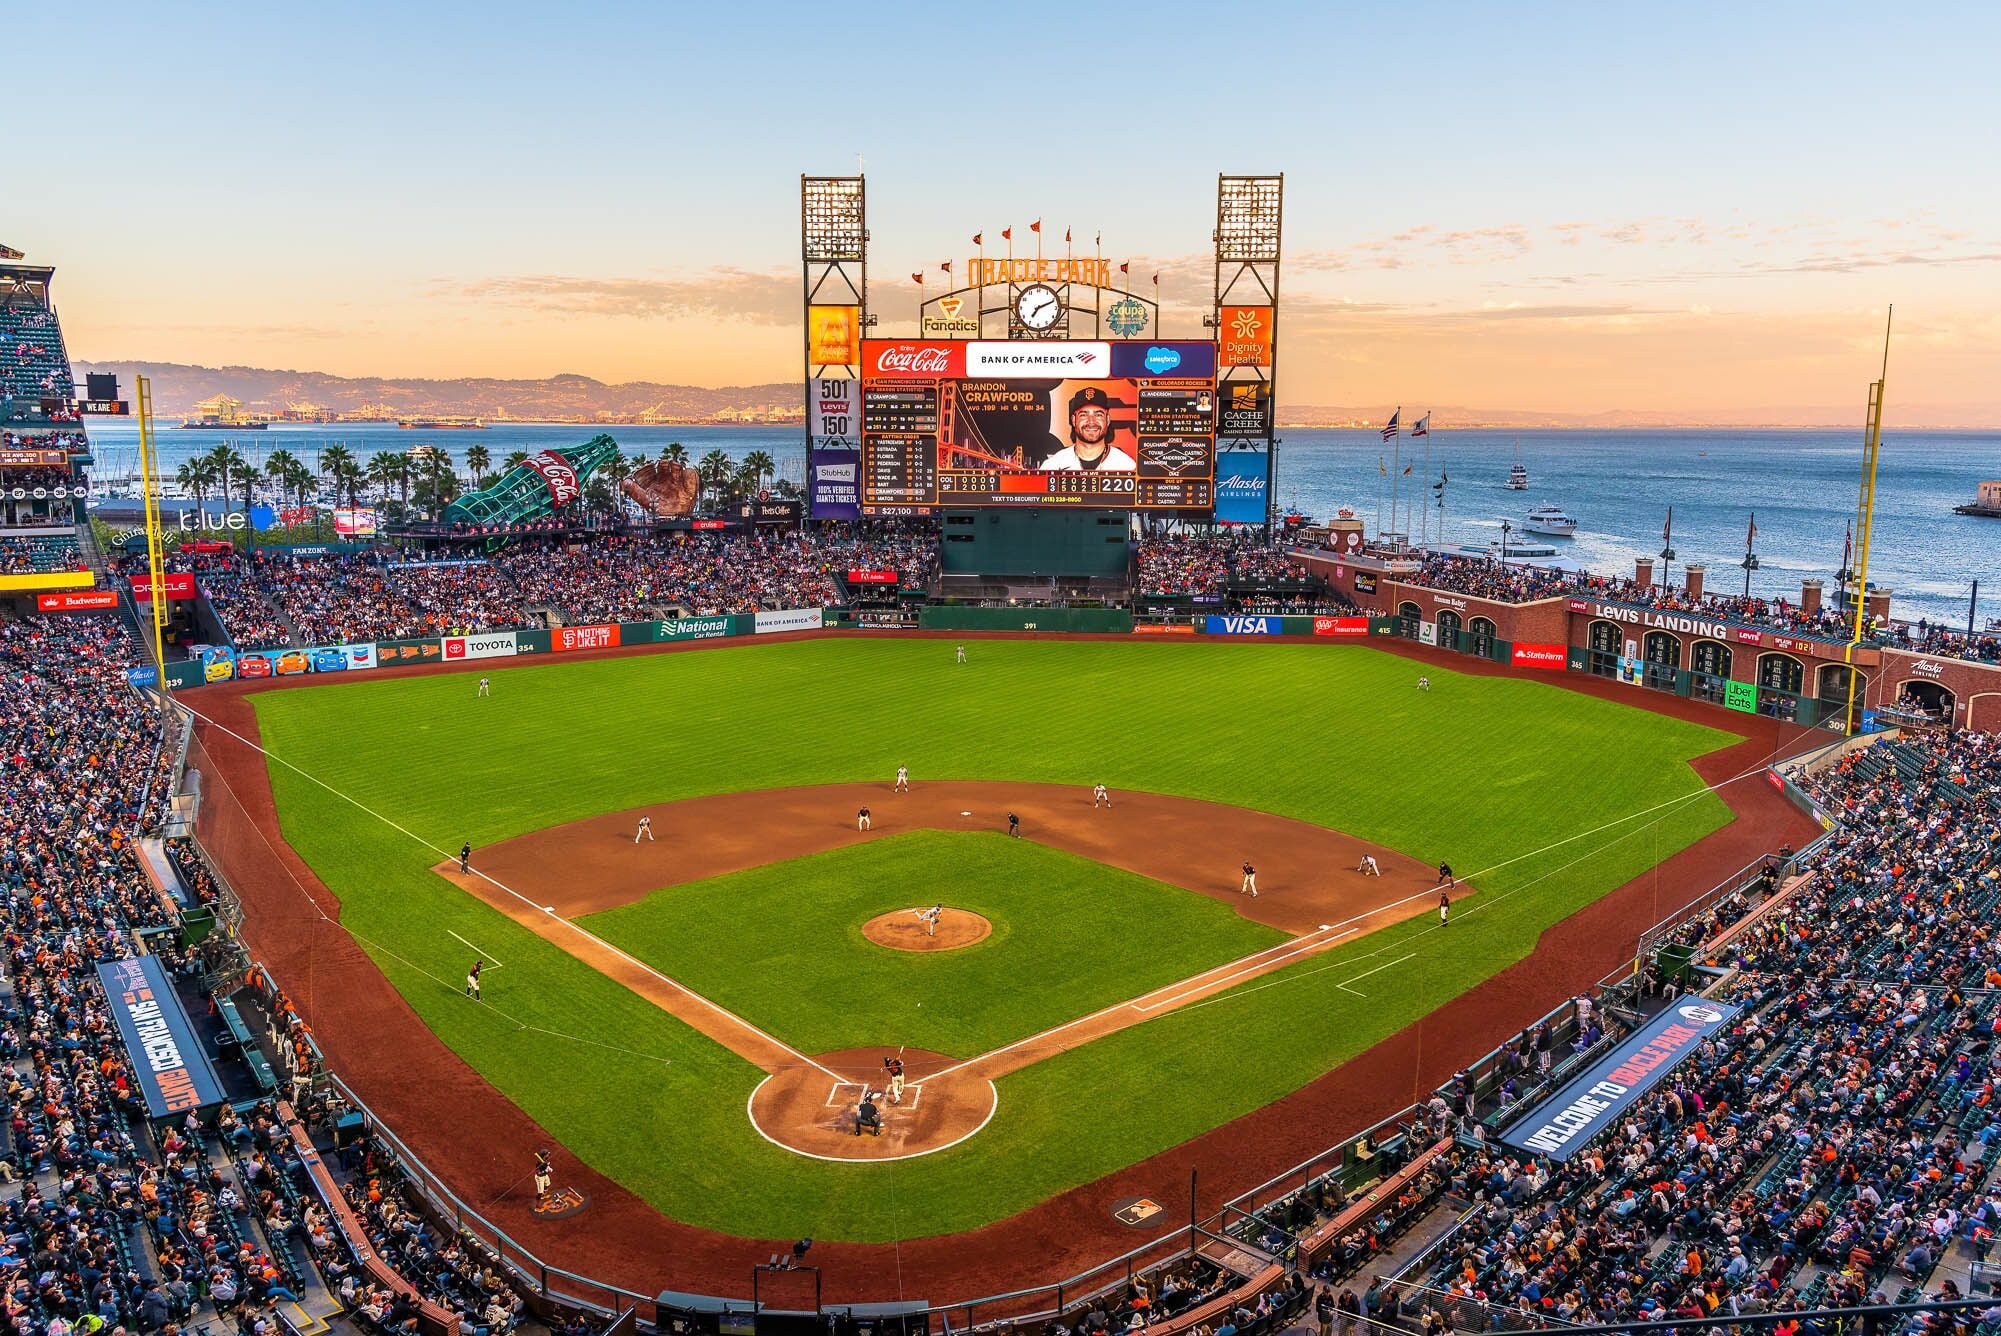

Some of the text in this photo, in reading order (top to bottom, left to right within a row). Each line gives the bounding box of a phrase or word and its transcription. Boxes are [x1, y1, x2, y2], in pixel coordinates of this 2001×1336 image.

[968, 258, 1112, 289] ORACLE PARK
[1112, 306, 1145, 318] coupa
[924, 318, 978, 333] Fanatics
[1227, 342, 1264, 355] Dignity
[877, 347, 953, 372] Coca-Cola
[981, 356, 1074, 364] BANK OF AMERICA
[1149, 356, 1178, 364] salesforce
[962, 383, 1006, 391] BRANDON
[966, 392, 1034, 402] CRAWFORD
[86, 403, 110, 412] WE ARE
[1224, 411, 1264, 420] CACHE
[1225, 420, 1262, 428] CREEK
[821, 469, 851, 477] StubHub
[1102, 478, 1134, 491] 2 2 0
[1217, 474, 1266, 490] Alaska
[817, 486, 855, 494] 100% VERIFIED
[816, 494, 857, 503] GIANTS TICKETS
[775, 506, 791, 516] Coffee
[179, 507, 245, 532] blue
[66, 596, 112, 606] Budweiser
[676, 618, 728, 634] National
[773, 619, 781, 627] OF
[781, 618, 808, 626] AMERICA
[1221, 618, 1268, 634] VISA
[1644, 612, 1727, 640] LANDING
[576, 626, 610, 638] NOTHING
[562, 630, 576, 649] SF
[577, 634, 609, 648] LIKE IT
[1774, 638, 1792, 646] SPLASH
[469, 640, 513, 652] TOYOTA
[518, 644, 534, 652] 354
[1796, 642, 1808, 651] 102
[1910, 659, 1944, 674] Alaska
[128, 670, 154, 680] Alaska
[1912, 670, 1940, 678] AIRLINES
[1729, 684, 1752, 697] Uber
[1728, 695, 1750, 709] Eats
[1828, 720, 1846, 731] 309
[128, 1000, 162, 1022] SAN
[137, 1018, 184, 1072] FRANCISCO
[154, 1068, 202, 1111] GIANTS
[1522, 1022, 1700, 1153] WELCOME TO ORACLE PARK
